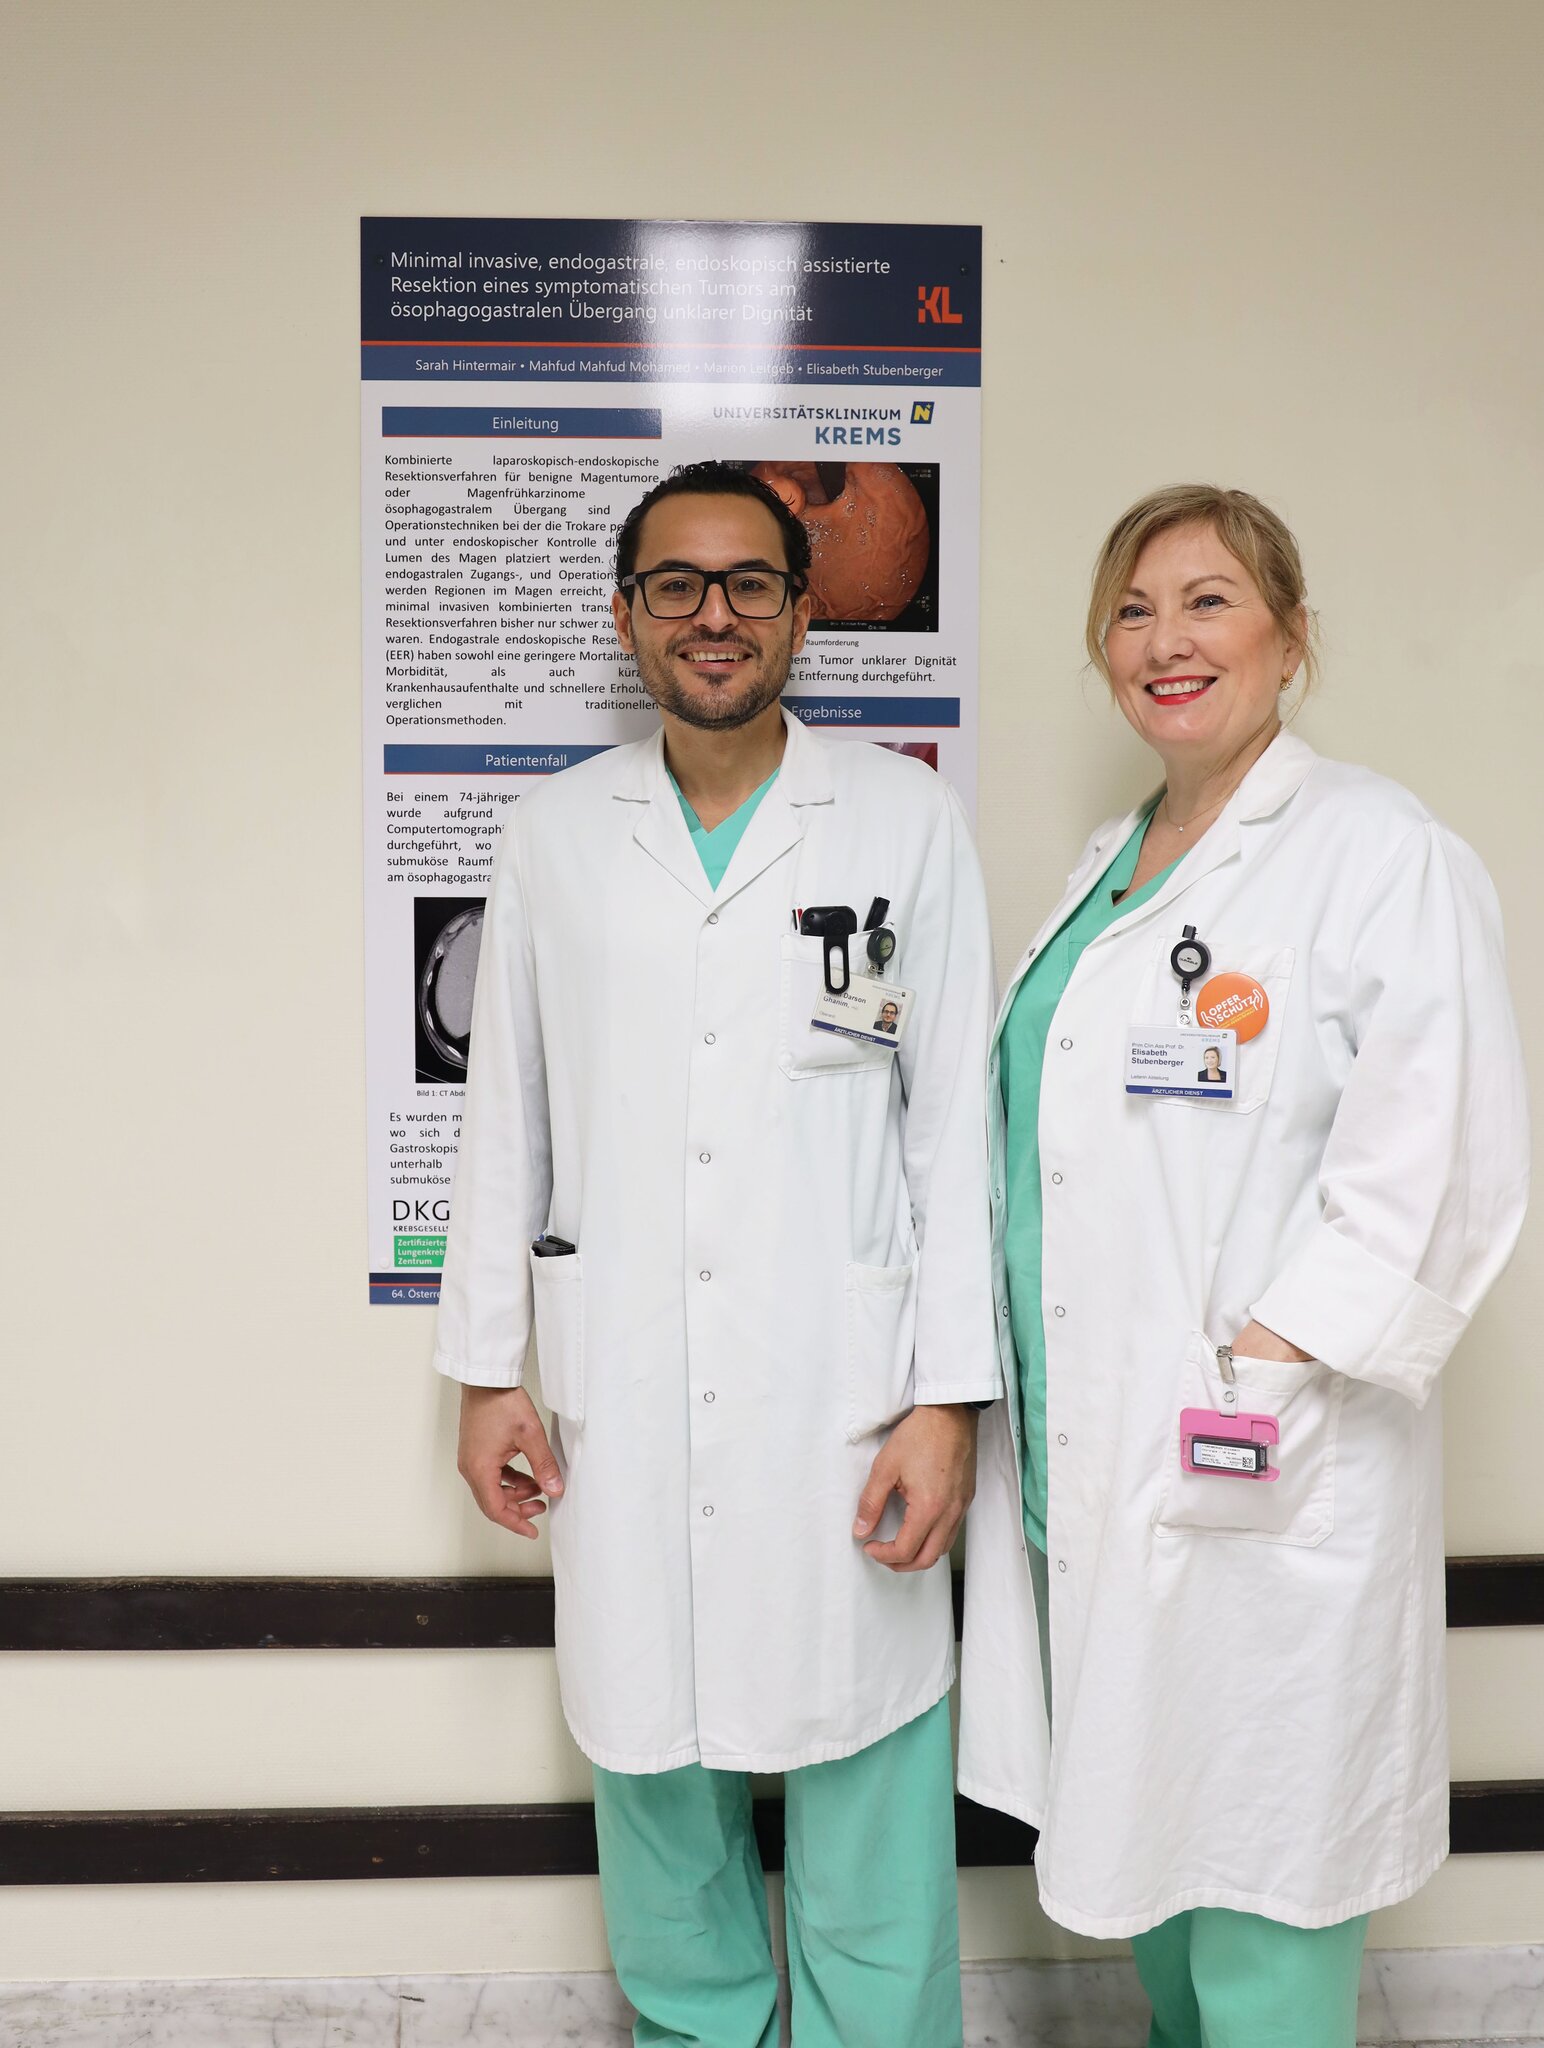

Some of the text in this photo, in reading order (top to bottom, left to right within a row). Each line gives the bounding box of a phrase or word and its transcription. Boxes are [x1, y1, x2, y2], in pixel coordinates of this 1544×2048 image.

[390, 252, 891, 275] Minimal invasive, endogastrale, endoskopisch assistierte
[389, 276, 797, 298] Resektion eines symptomatischen Tumors am
[389, 299, 813, 325] ösophagogastralen Übergang unklarer Dignität
[415, 358, 449, 371] Sarah
[453, 358, 516, 372] Hintermair
[529, 359, 575, 373] Mahfud
[579, 359, 625, 373] Mahfud
[806, 362, 857, 376] Elisabeth
[861, 362, 943, 380] Stubenberger
[713, 405, 900, 421] UNIVERSITÄTSKLINIKUM
[493, 416, 559, 433] Einleitung
[815, 426, 901, 446] KREMS
[385, 455, 659, 468] Kombinierte laparoskopisch-endoskopische
[385, 471, 659, 485] Resektionsverfahren für benigne Magentumore
[384, 487, 586, 501] oder Magenfrühkarzinome
[384, 502, 610, 517] ösophagogastralem Übergang sind
[385, 520, 499, 532] Operationstechniken
[502, 520, 519, 531] bei
[523, 520, 542, 531] der
[544, 520, 562, 531] die
[565, 521, 607, 531] Trokare
[385, 536, 406, 546] und
[415, 537, 445, 547] unter
[452, 536, 539, 549] endoskopischer
[547, 537, 597, 548] Kontrolle
[385, 553, 422, 563] Lumen
[431, 552, 450, 563] des
[459, 553, 497, 566] Magen
[505, 553, 550, 565] platziert
[559, 553, 604, 564] werden.
[385, 568, 463, 581] endogastralen
[470, 569, 523, 582] Zugangs-,
[530, 569, 551, 580] und
[385, 585, 606, 598] werden Regionen im Magen erreicht,
[385, 601, 430, 612] minimal
[439, 601, 489, 612] invasiven
[499, 601, 572, 612] kombinierten
[385, 617, 497, 628] Resektionsverfahren
[500, 618, 535, 629] bisher
[538, 620, 557, 629] nur
[559, 618, 599, 629] schwer
[385, 634, 621, 647] waren. Endogastrale endoskopische Rese
[385, 649, 414, 662] (EER)
[417, 650, 452, 660] haben
[455, 650, 494, 660] sowohl
[497, 650, 521, 661] eine
[523, 650, 576, 663] geringere
[819, 654, 854, 665] Tumor
[861, 655, 907, 666] unklarer
[914, 655, 957, 668] Dignität
[386, 666, 640, 678] Morbidität, als auch kürz
[799, 670, 859, 684] Entfernung
[861, 671, 935, 684] durchgeführt.
[386, 682, 649, 694] Krankenhausaufenthalte und schnellere Erholu
[385, 698, 442, 711] verglichen
[504, 699, 523, 709] mit
[791, 705, 862, 721] Ergebnisse
[386, 714, 506, 727] Operationsmethoden.
[485, 753, 567, 767] Patientenfall
[387, 791, 404, 802] Bei
[414, 792, 448, 802] einem
[386, 807, 493, 820] wurde aufgrund
[387, 839, 492, 852] durchgeführt, wo
[387, 856, 495, 867] submuköse Raumf
[387, 874, 404, 882] am
[1209, 994, 1241, 1016] OPFER
[1216, 995, 1254, 1022] SCHUTZ
[1131, 1048, 1168, 1056] Elisabeth
[1131, 1057, 1184, 1067] Stubenberger
[390, 1112, 401, 1122] Es
[405, 1112, 447, 1122] wurden
[389, 1128, 440, 1138] wo sich
[389, 1143, 458, 1155] Gastroskopis
[390, 1159, 443, 1169] unterhalb
[390, 1174, 451, 1185] submuköse
[393, 1200, 450, 1220] DKG
[398, 1248, 445, 1257] Lungenkreb
[391, 1289, 406, 1298] 64.
